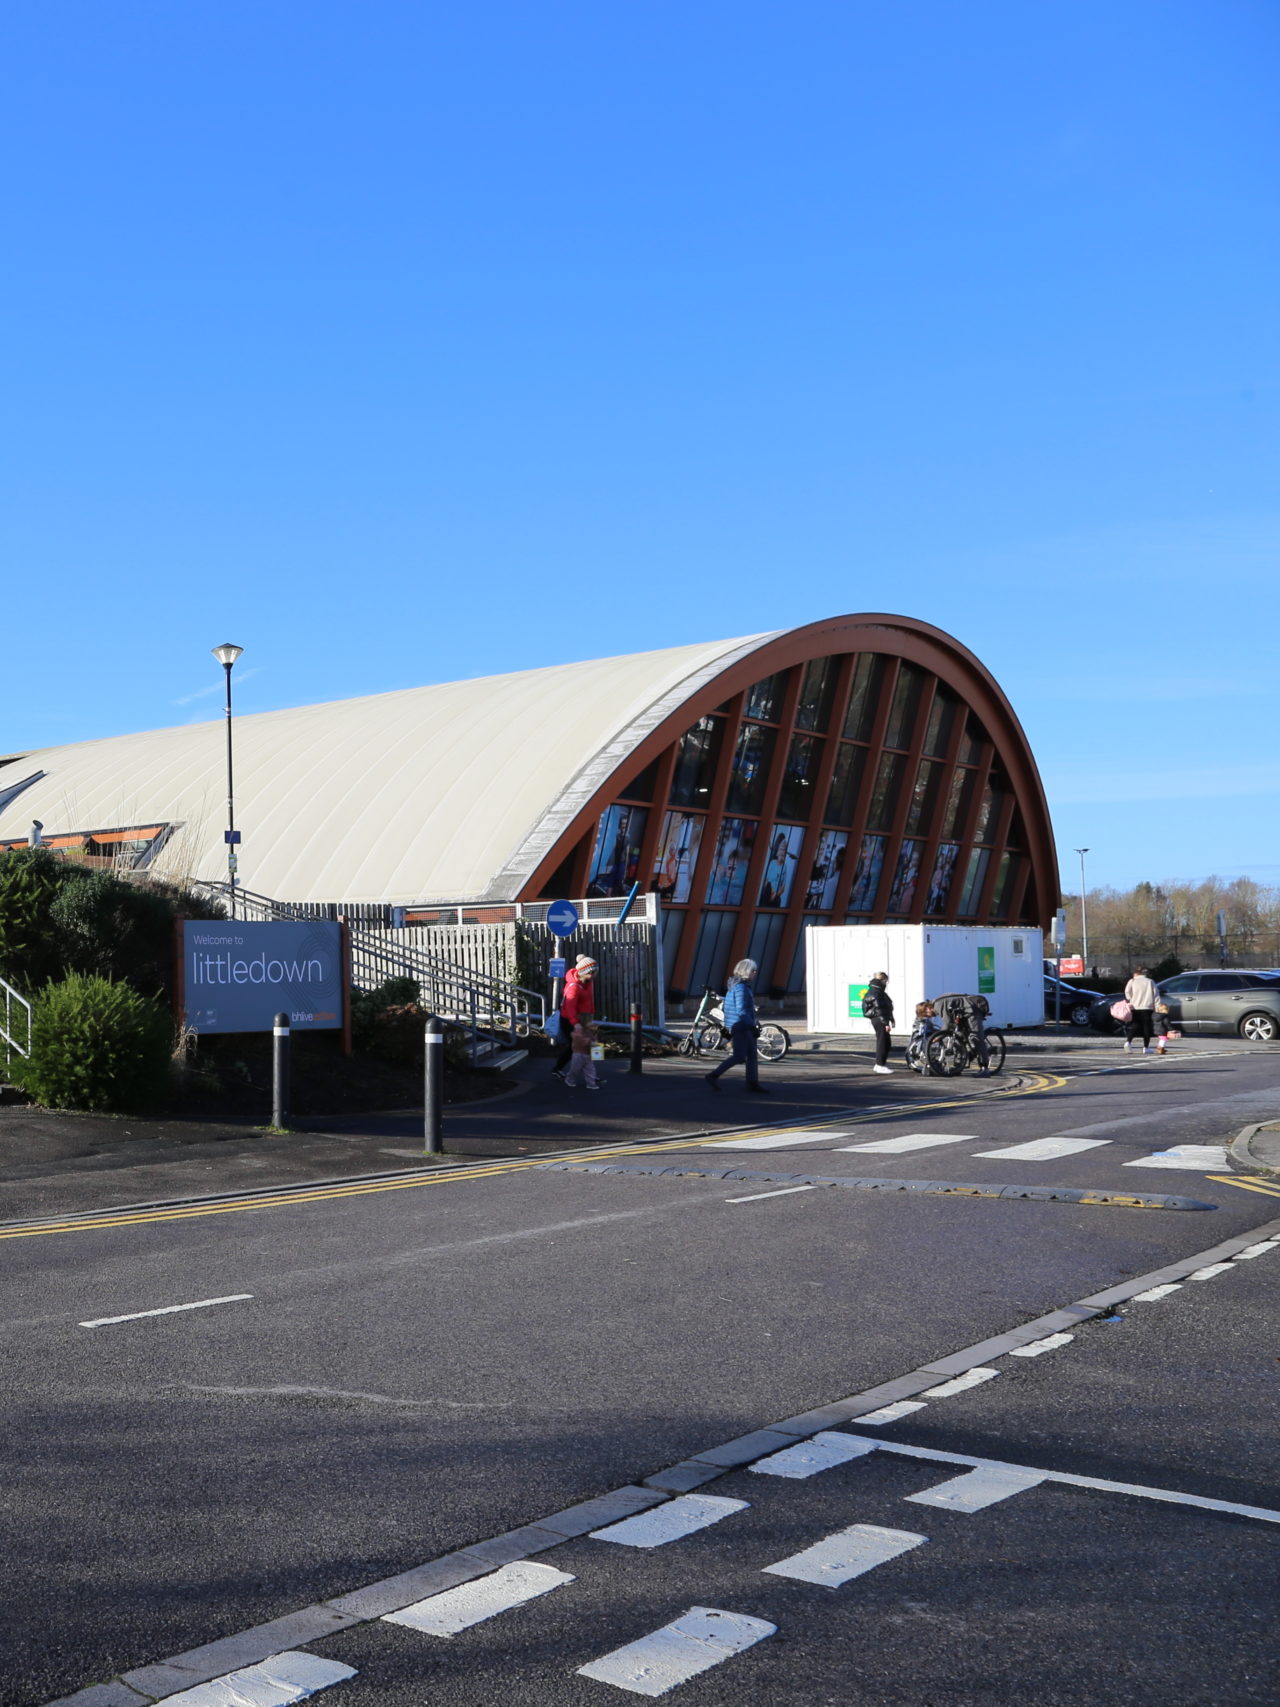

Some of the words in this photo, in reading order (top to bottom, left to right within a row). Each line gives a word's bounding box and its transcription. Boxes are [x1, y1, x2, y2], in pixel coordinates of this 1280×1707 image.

[193, 935, 233, 945] Welcome
[235, 935, 244, 945] to
[193, 951, 323, 985] littledown
